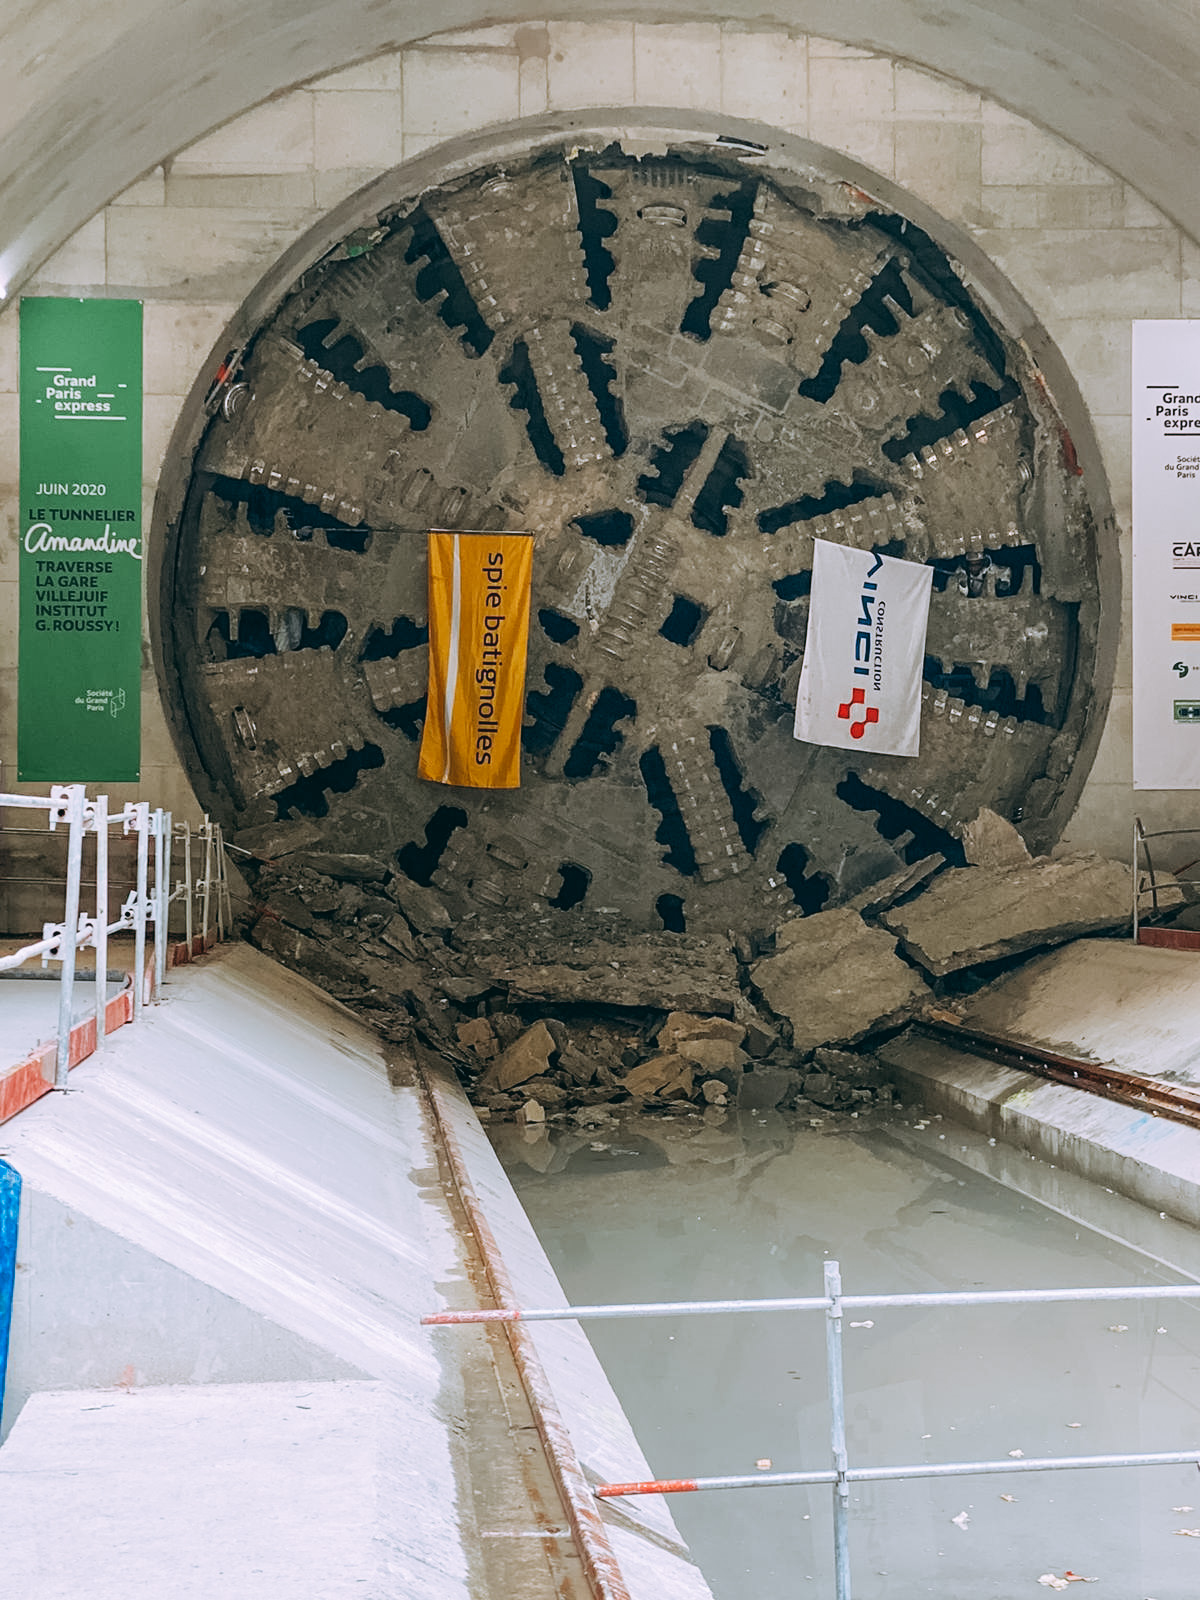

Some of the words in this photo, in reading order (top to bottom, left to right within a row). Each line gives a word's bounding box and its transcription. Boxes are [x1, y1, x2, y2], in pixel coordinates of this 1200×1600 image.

[53, 374, 97, 387] Grand
[46, 387, 82, 399] Paris
[54, 401, 111, 414] express
[1155, 405, 1189, 417] Paris
[1164, 419, 1200, 431] expre
[1164, 463, 1175, 471] du
[1176, 463, 1199, 471] Grand
[1176, 471, 1196, 479] Paris
[36, 483, 69, 495] JUIN
[72, 483, 107, 496] 2020
[29, 508, 46, 521] LE
[49, 509, 136, 522] TUNNELIER
[35, 560, 113, 573] TRAVERSE
[36, 575, 54, 587] LA
[58, 576, 98, 588] GARE
[482, 552, 507, 608] spie
[35, 590, 108, 602] VILLEJUIF
[35, 605, 107, 617] INSTITUT
[475, 616, 506, 765] batignolles
